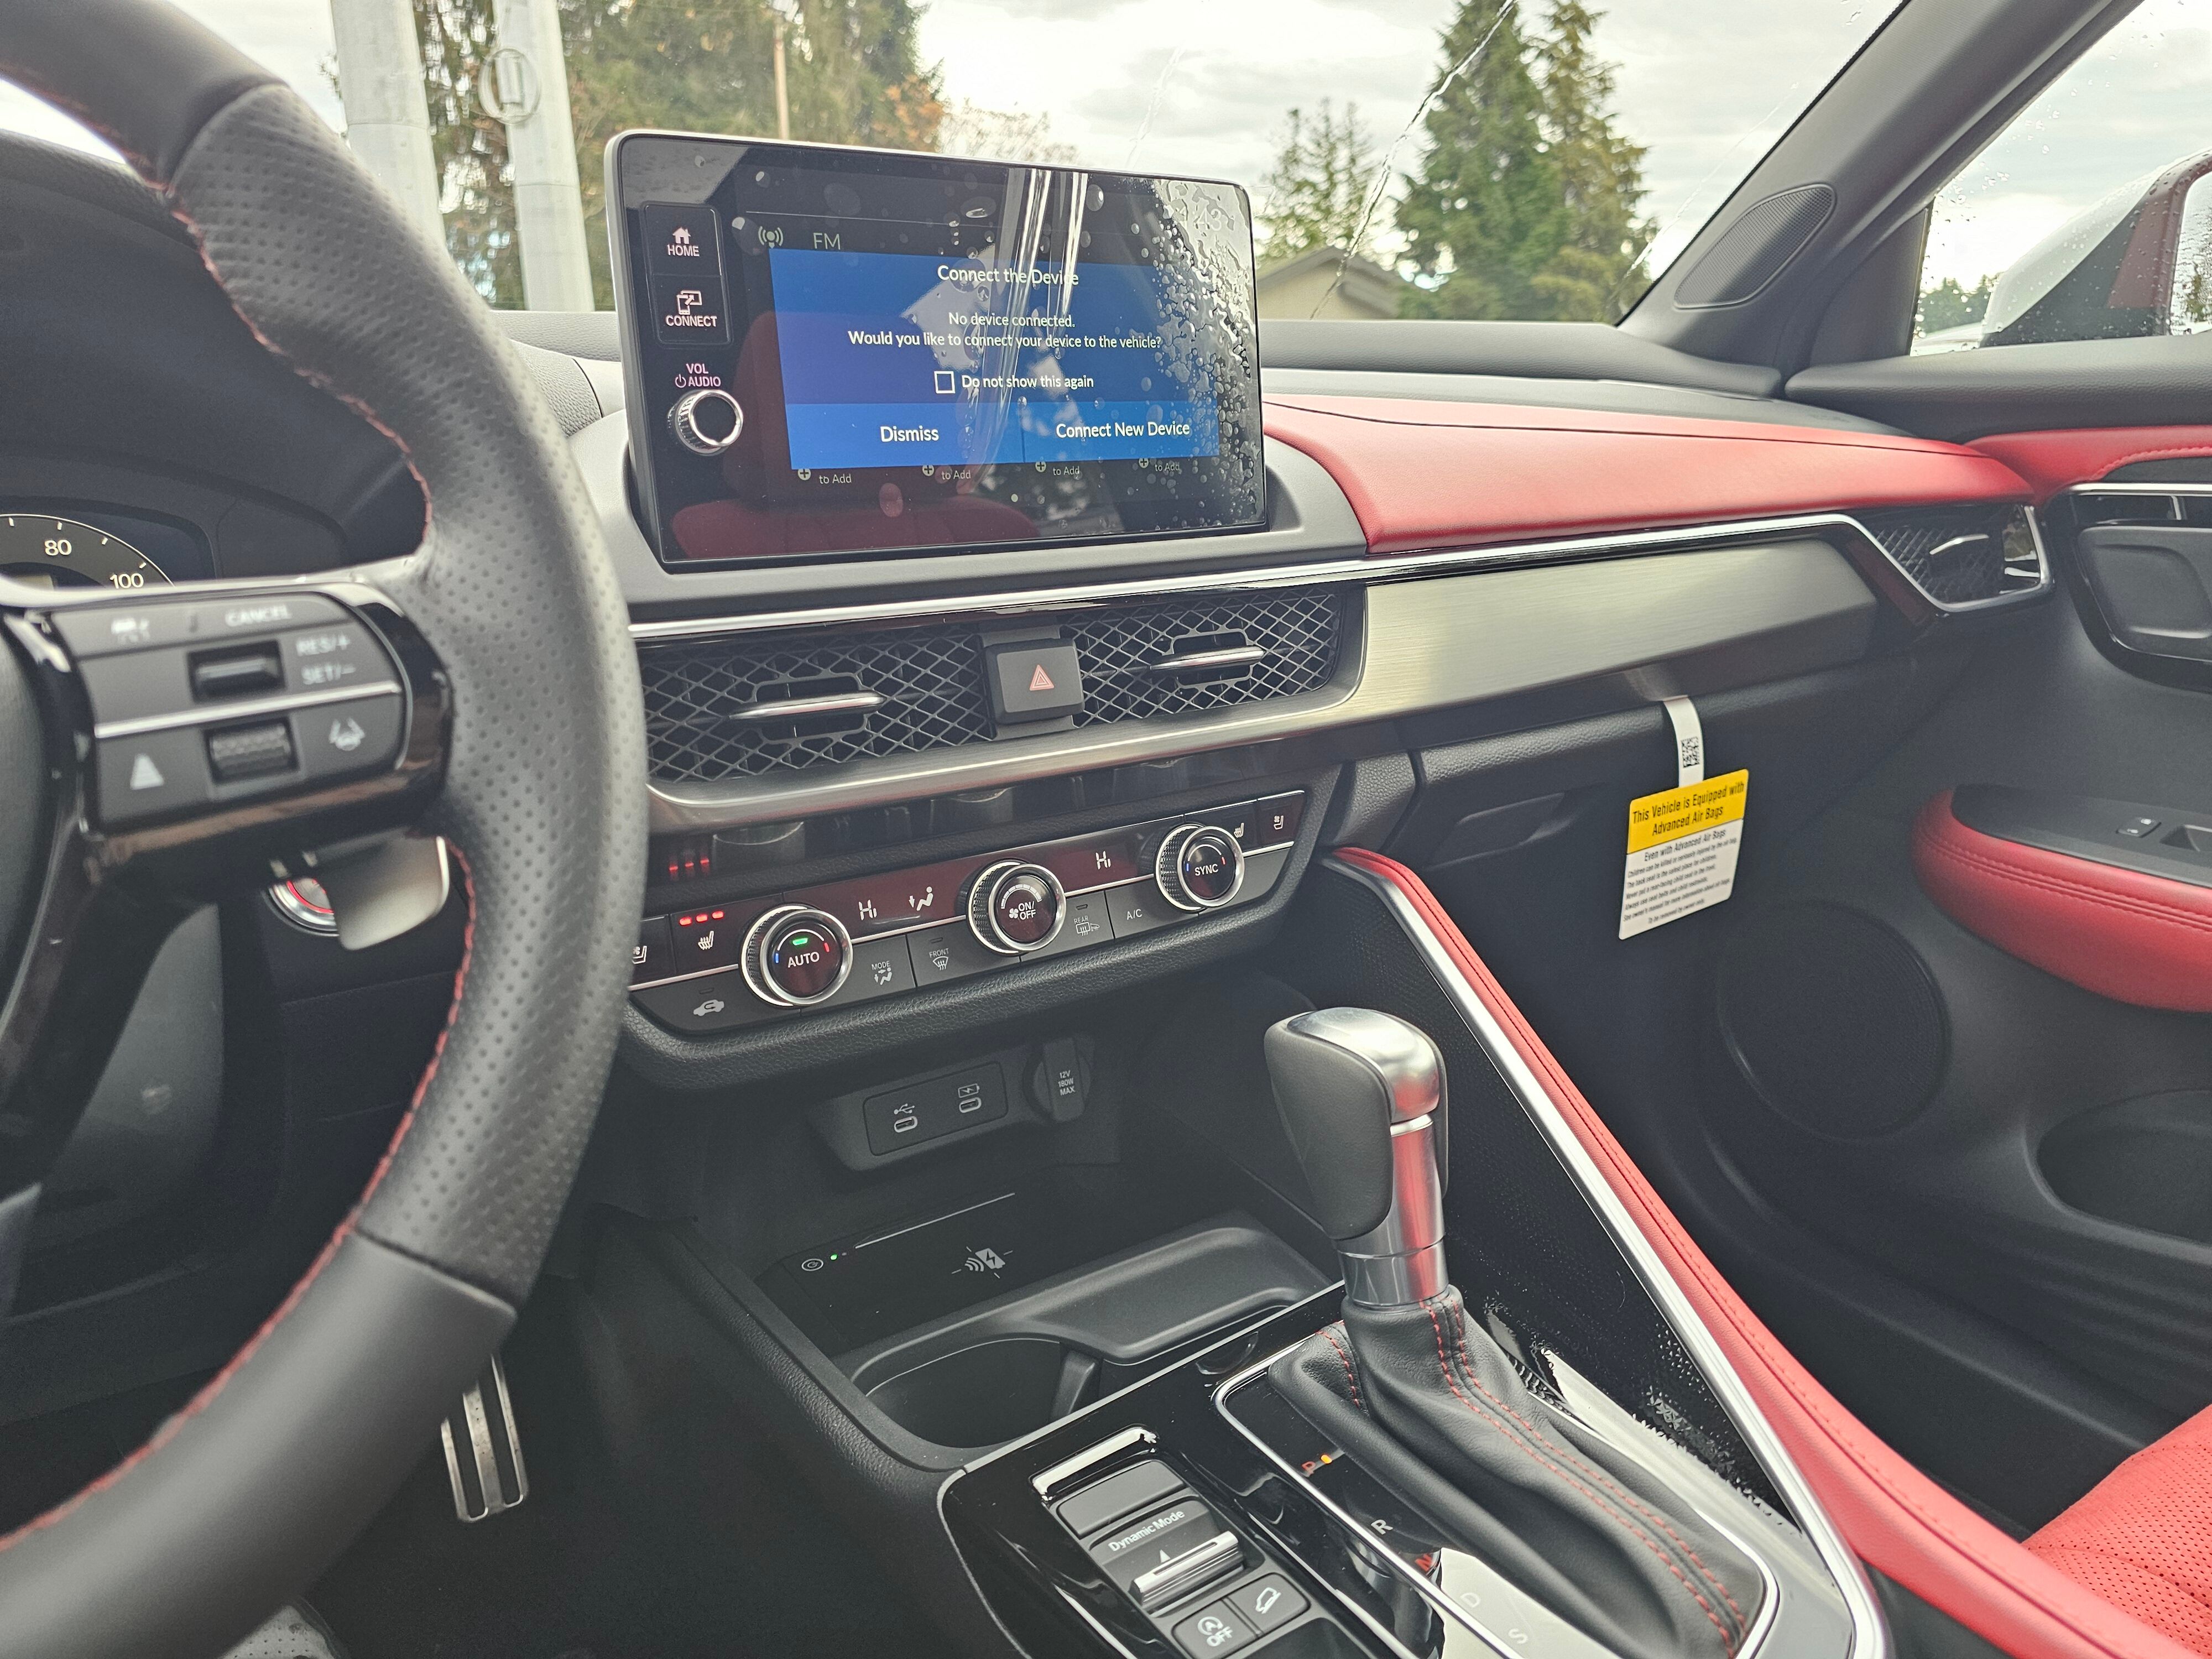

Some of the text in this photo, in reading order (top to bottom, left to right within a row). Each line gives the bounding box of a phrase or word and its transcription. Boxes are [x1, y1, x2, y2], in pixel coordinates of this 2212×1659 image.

[813, 232, 841, 250] FM
[667, 244, 700, 257] HOME
[937, 264, 1079, 285] Connect the Device
[666, 315, 717, 327] CONNECT
[948, 312, 1075, 328] No device connected.
[848, 330, 1161, 349] Would you like to connect your device to the vehicle?
[686, 363, 708, 374] VOL
[688, 376, 721, 387] AUDIO
[962, 375, 1094, 390] Do not show this again
[880, 425, 938, 442] Dismiss
[1056, 420, 1190, 438] Connect New Device
[941, 469, 971, 480] to Add
[1052, 466, 1079, 476] to Add
[1155, 462, 1180, 472] to Add
[819, 473, 852, 484] to Add
[44, 539, 72, 556] 80
[110, 573, 144, 589] 100
[225, 604, 292, 627] CANCEL
[1633, 781, 1744, 823] This Vehicle is Equipped with
[1652, 806, 1723, 836] Advanced Air Bags
[1645, 852, 1658, 861] Even
[1660, 846, 1672, 856] with
[1674, 837, 1701, 852] Advanced
[1713, 830, 1726, 839] Bags
[1194, 864, 1218, 877] SYNC
[1018, 901, 1035, 913] ON/
[1019, 909, 1036, 920] OFF
[1126, 909, 1142, 920] A/C
[1074, 916, 1089, 925] REAR
[787, 951, 820, 968] AUTO
[929, 948, 950, 958] FRONT
[872, 960, 890, 971] MODE
[1060, 1070, 1071, 1079] 12V
[1058, 1077, 1074, 1088] 180W
[1060, 1086, 1076, 1096] MAX
[1302, 1460, 1316, 1475] P
[1108, 1510, 1185, 1552] Dynamic Mode
[1371, 1519, 1393, 1535] R
[1415, 1553, 1433, 1571] N
[1460, 1592, 1481, 1608] D
[1207, 1626, 1233, 1647] OFF
[1508, 1628, 1528, 1645] S
